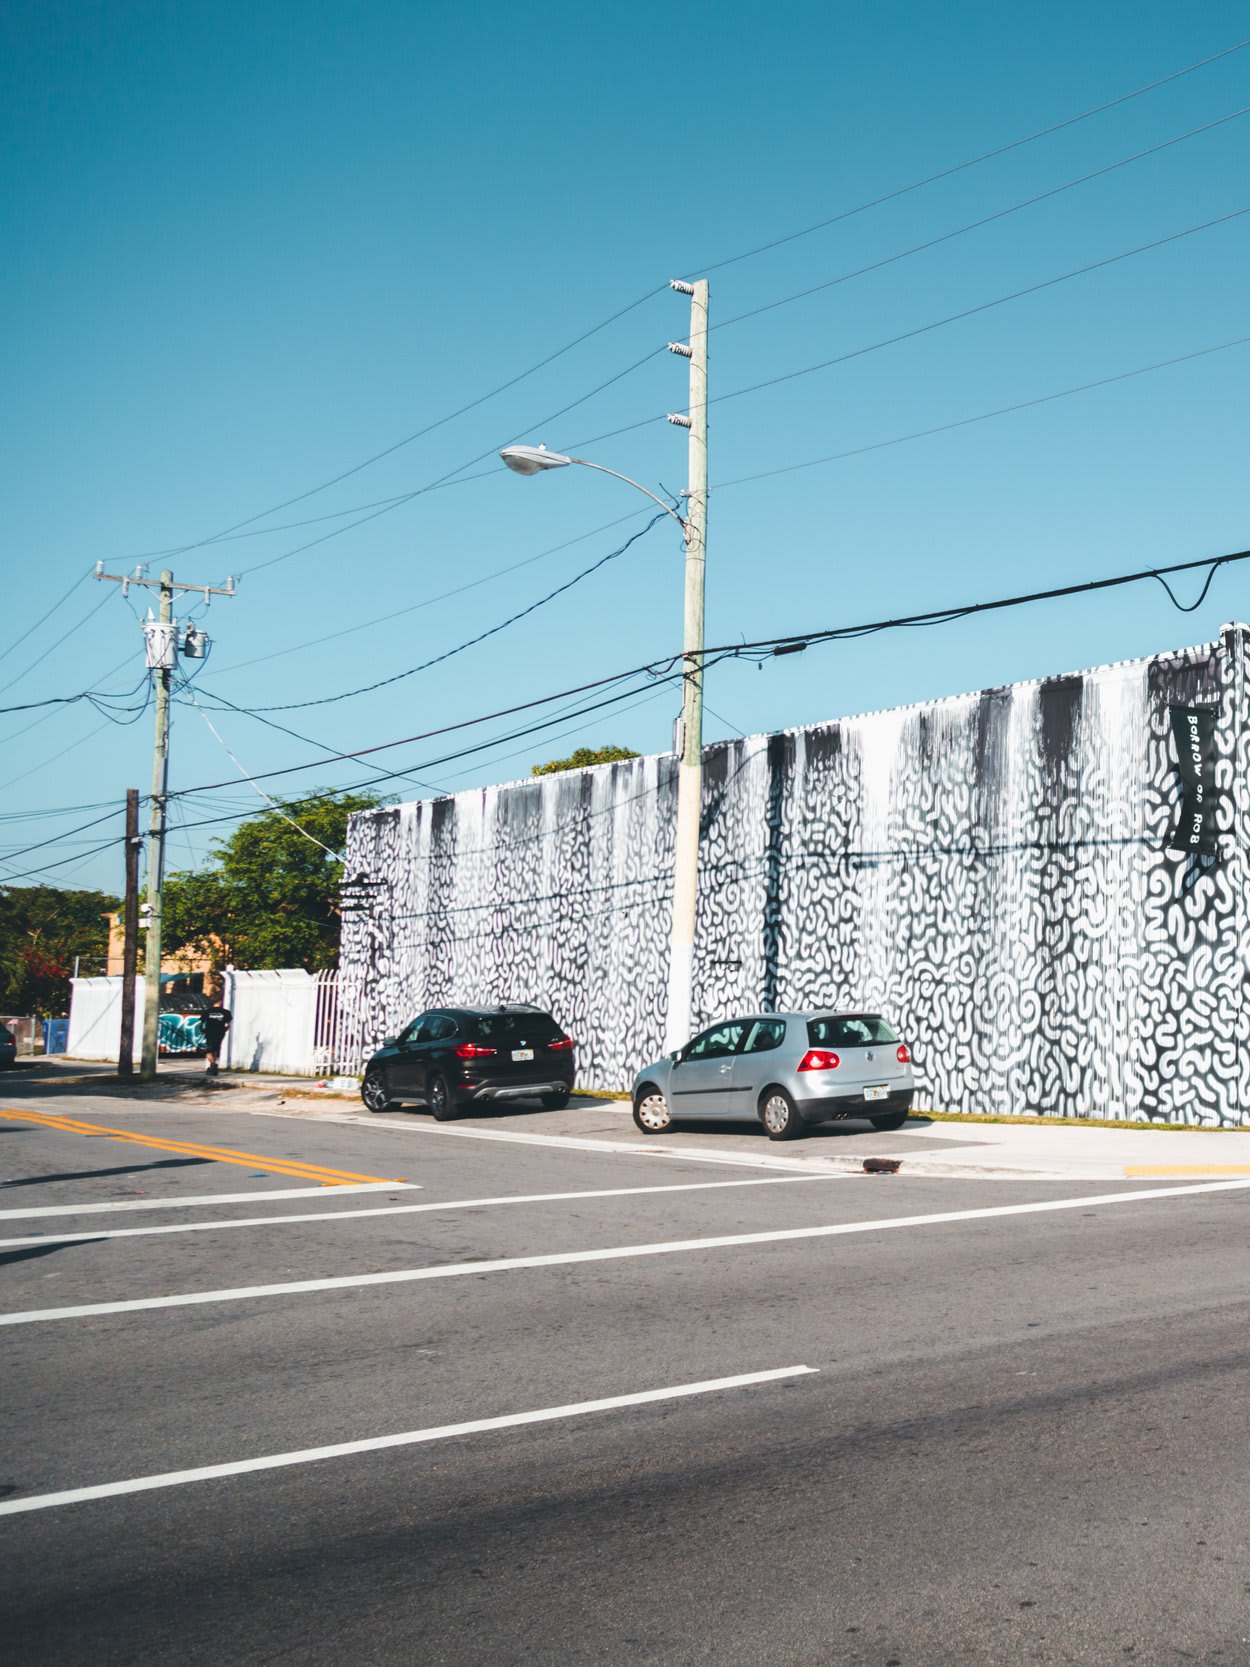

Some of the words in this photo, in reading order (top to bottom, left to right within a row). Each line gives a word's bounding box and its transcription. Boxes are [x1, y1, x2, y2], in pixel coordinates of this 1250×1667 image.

[1187, 716, 1202, 776] BORROW
[1196, 784, 1204, 803] OR
[1190, 813, 1203, 844] ROB
